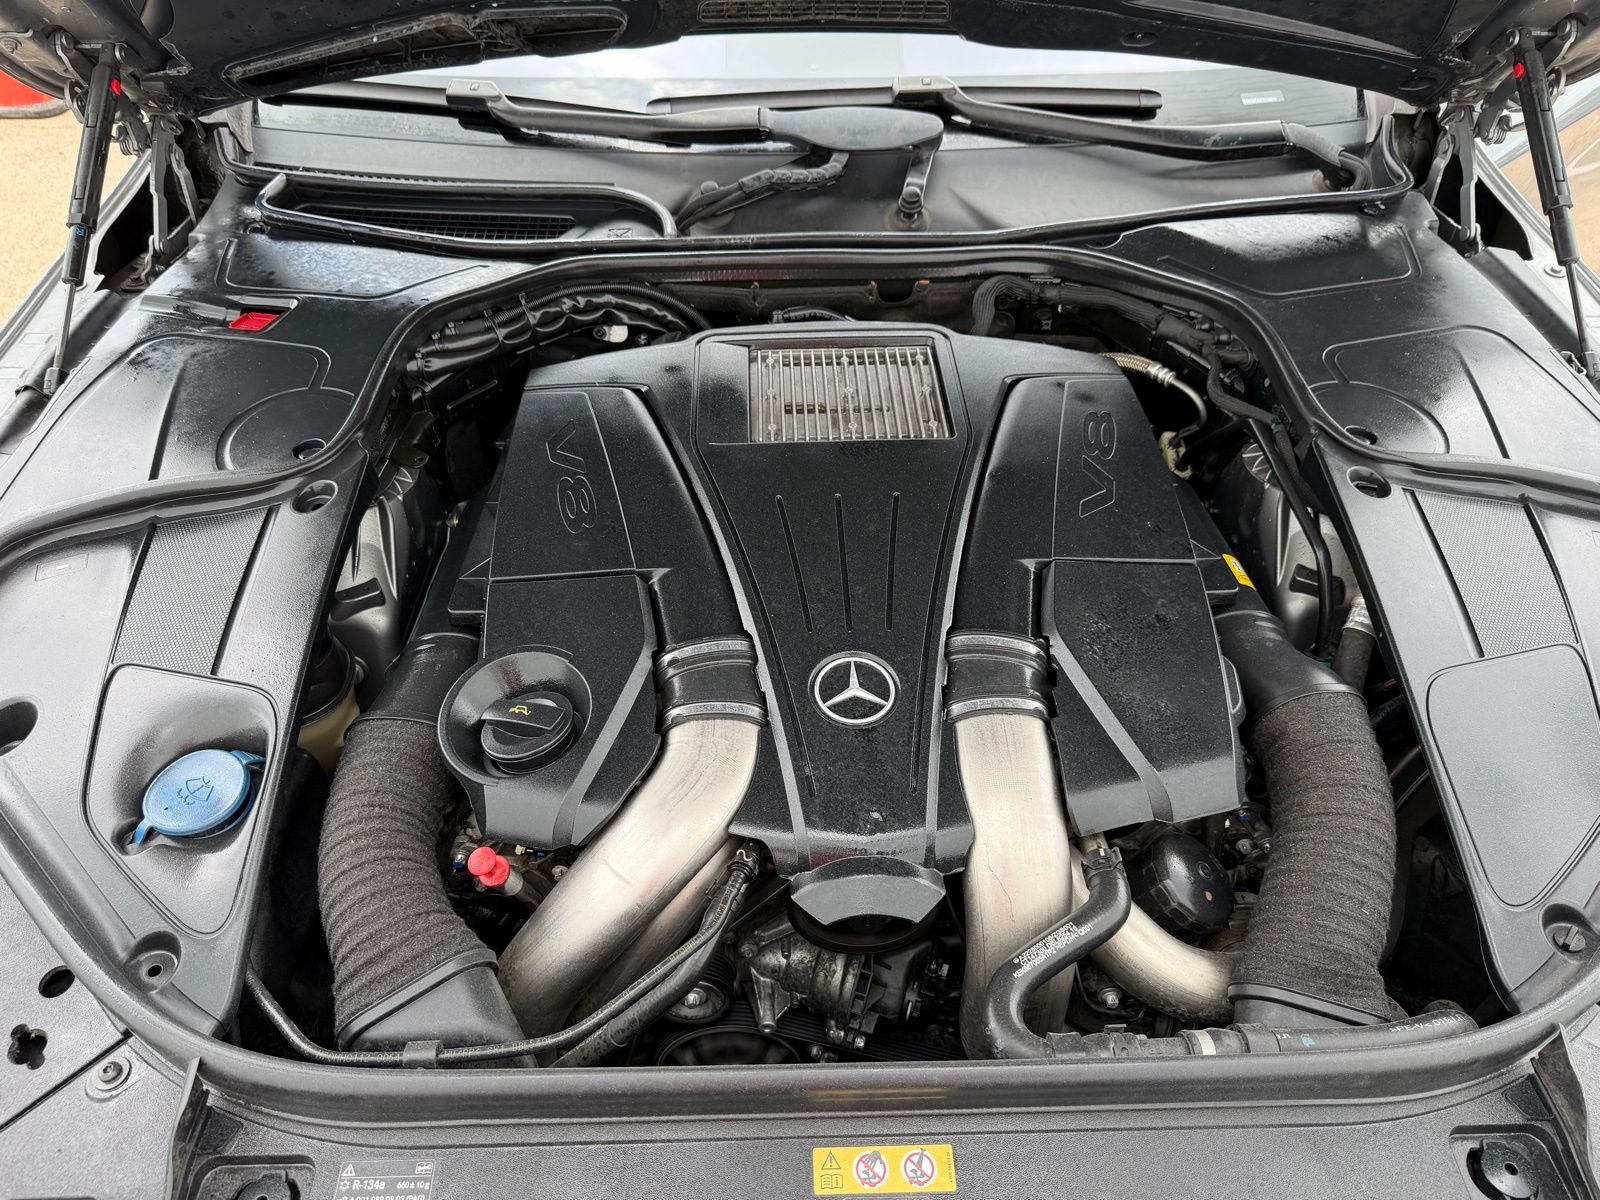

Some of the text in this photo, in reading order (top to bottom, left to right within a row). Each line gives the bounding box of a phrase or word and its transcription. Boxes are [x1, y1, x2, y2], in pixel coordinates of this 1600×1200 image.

[546, 419, 598, 534] V8
[1079, 410, 1117, 518] V8
[352, 1179, 386, 1190] R-134a
